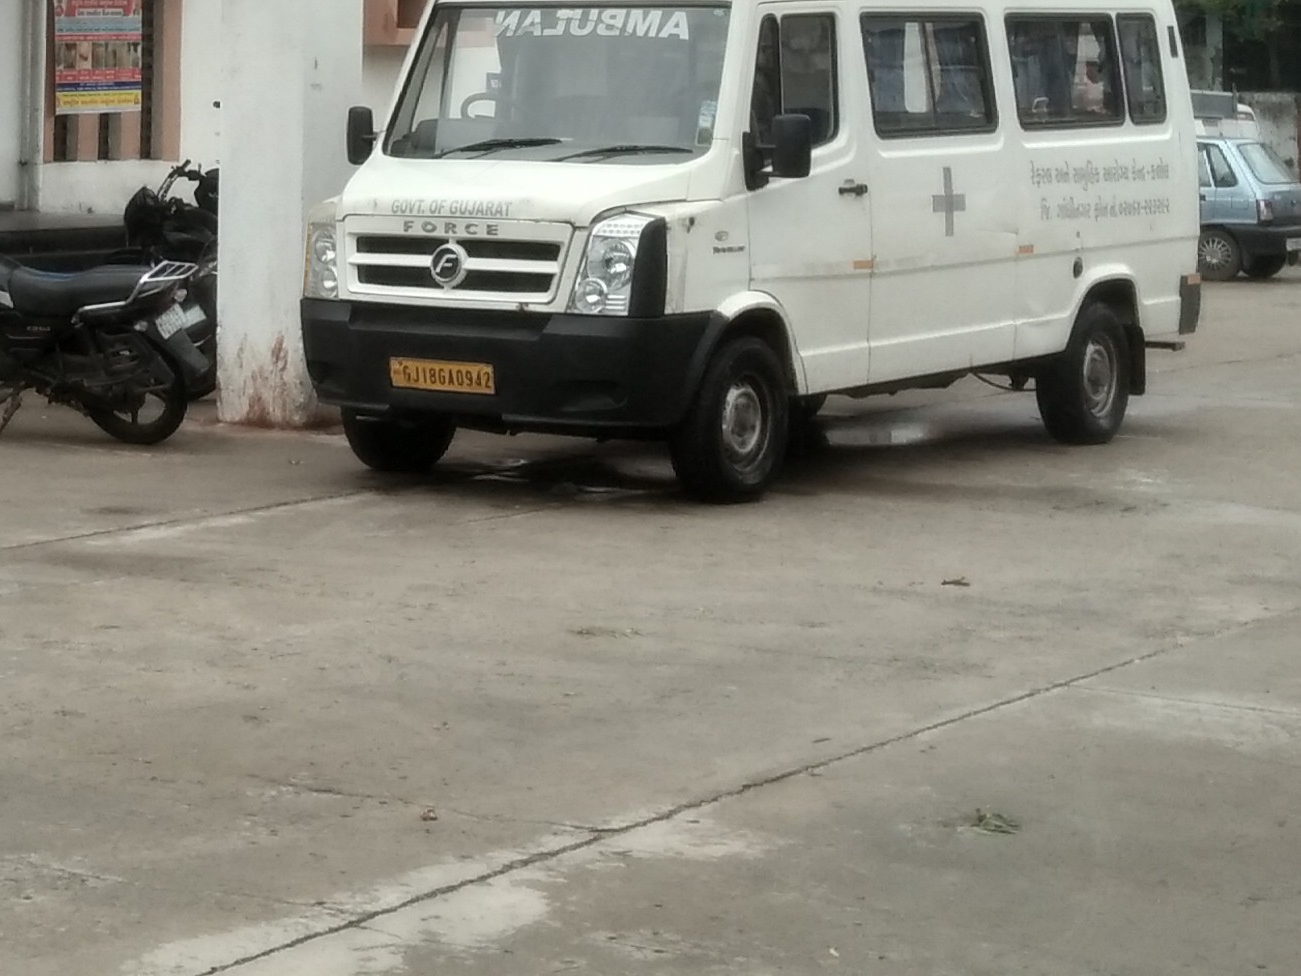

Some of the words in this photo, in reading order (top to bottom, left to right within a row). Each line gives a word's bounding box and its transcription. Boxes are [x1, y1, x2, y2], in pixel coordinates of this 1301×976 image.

[391, 198, 425, 215] GOVT.
[429, 199, 448, 215] OF
[449, 200, 513, 217] GUJARAT
[403, 220, 499, 236] FORCE
[403, 365, 492, 390] GJ18GA0942
